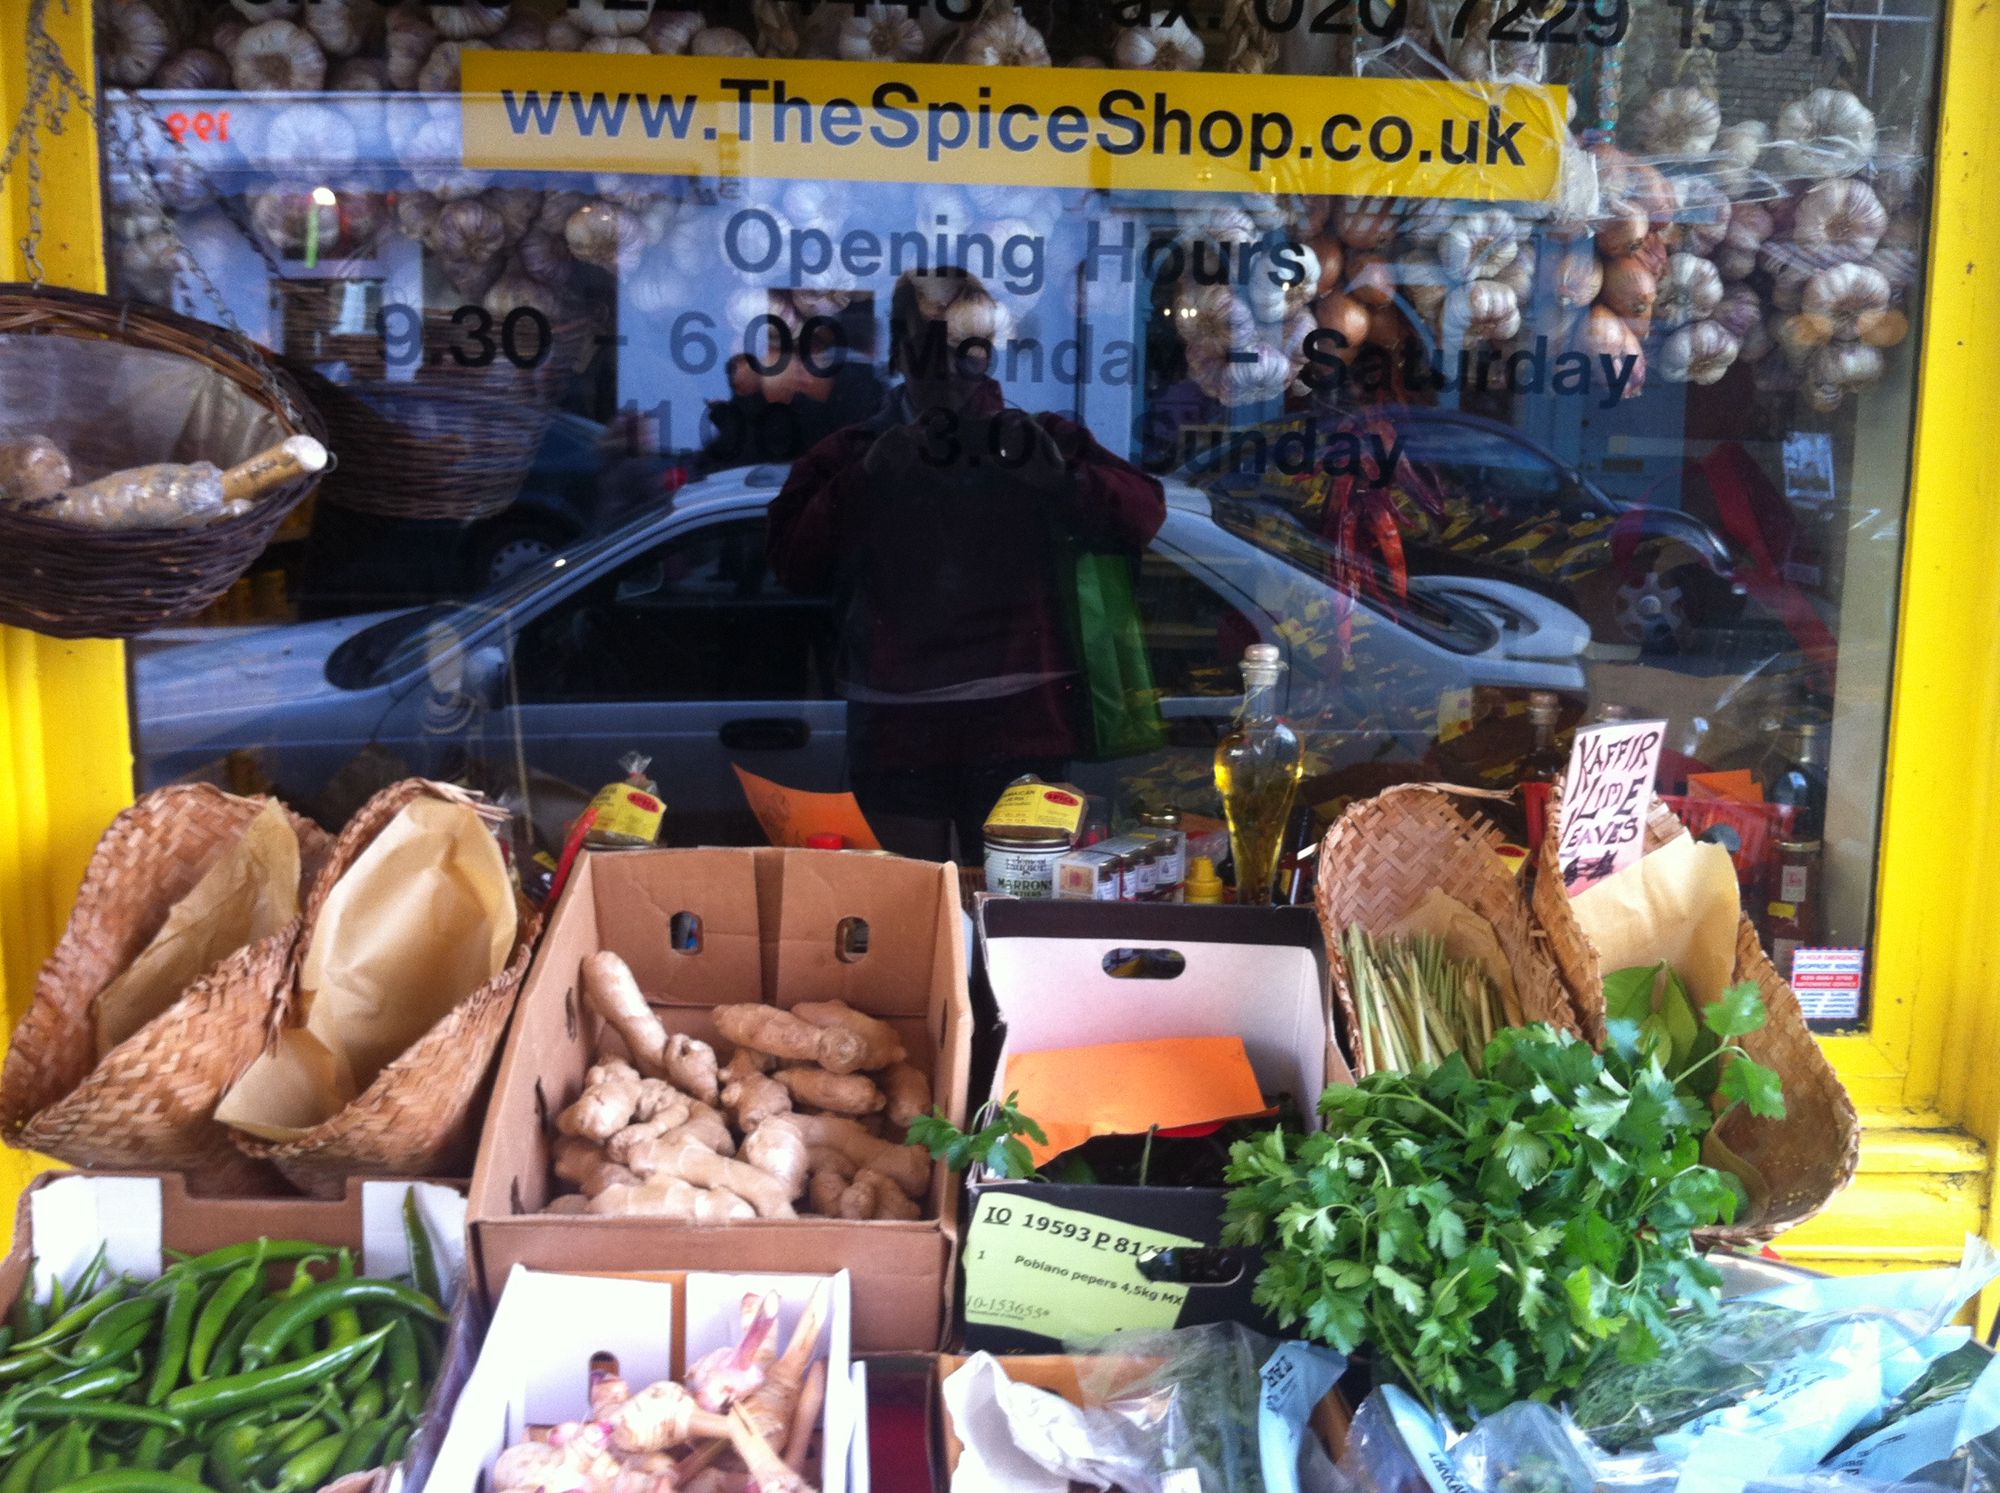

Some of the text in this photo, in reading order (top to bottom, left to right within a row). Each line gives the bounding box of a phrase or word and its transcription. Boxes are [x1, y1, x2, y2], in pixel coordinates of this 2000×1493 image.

[1672, 0, 1825, 57] 1591
[501, 78, 1526, 171] www.TheSpiceShop.co.uk
[723, 207, 1306, 296] Opening Hours
[376, 303, 553, 370] 9.30
[1302, 327, 1638, 410] Saturday
[1129, 409, 1406, 488] Sunday
[1021, 1212, 1091, 1244] 19593
[1091, 1230, 1112, 1252] P
[1013, 1253, 1070, 1279] Poblano
[1070, 1269, 1118, 1293] pepers
[1120, 1281, 1159, 1305] 4,5kg
[1160, 1292, 1184, 1307] MX
